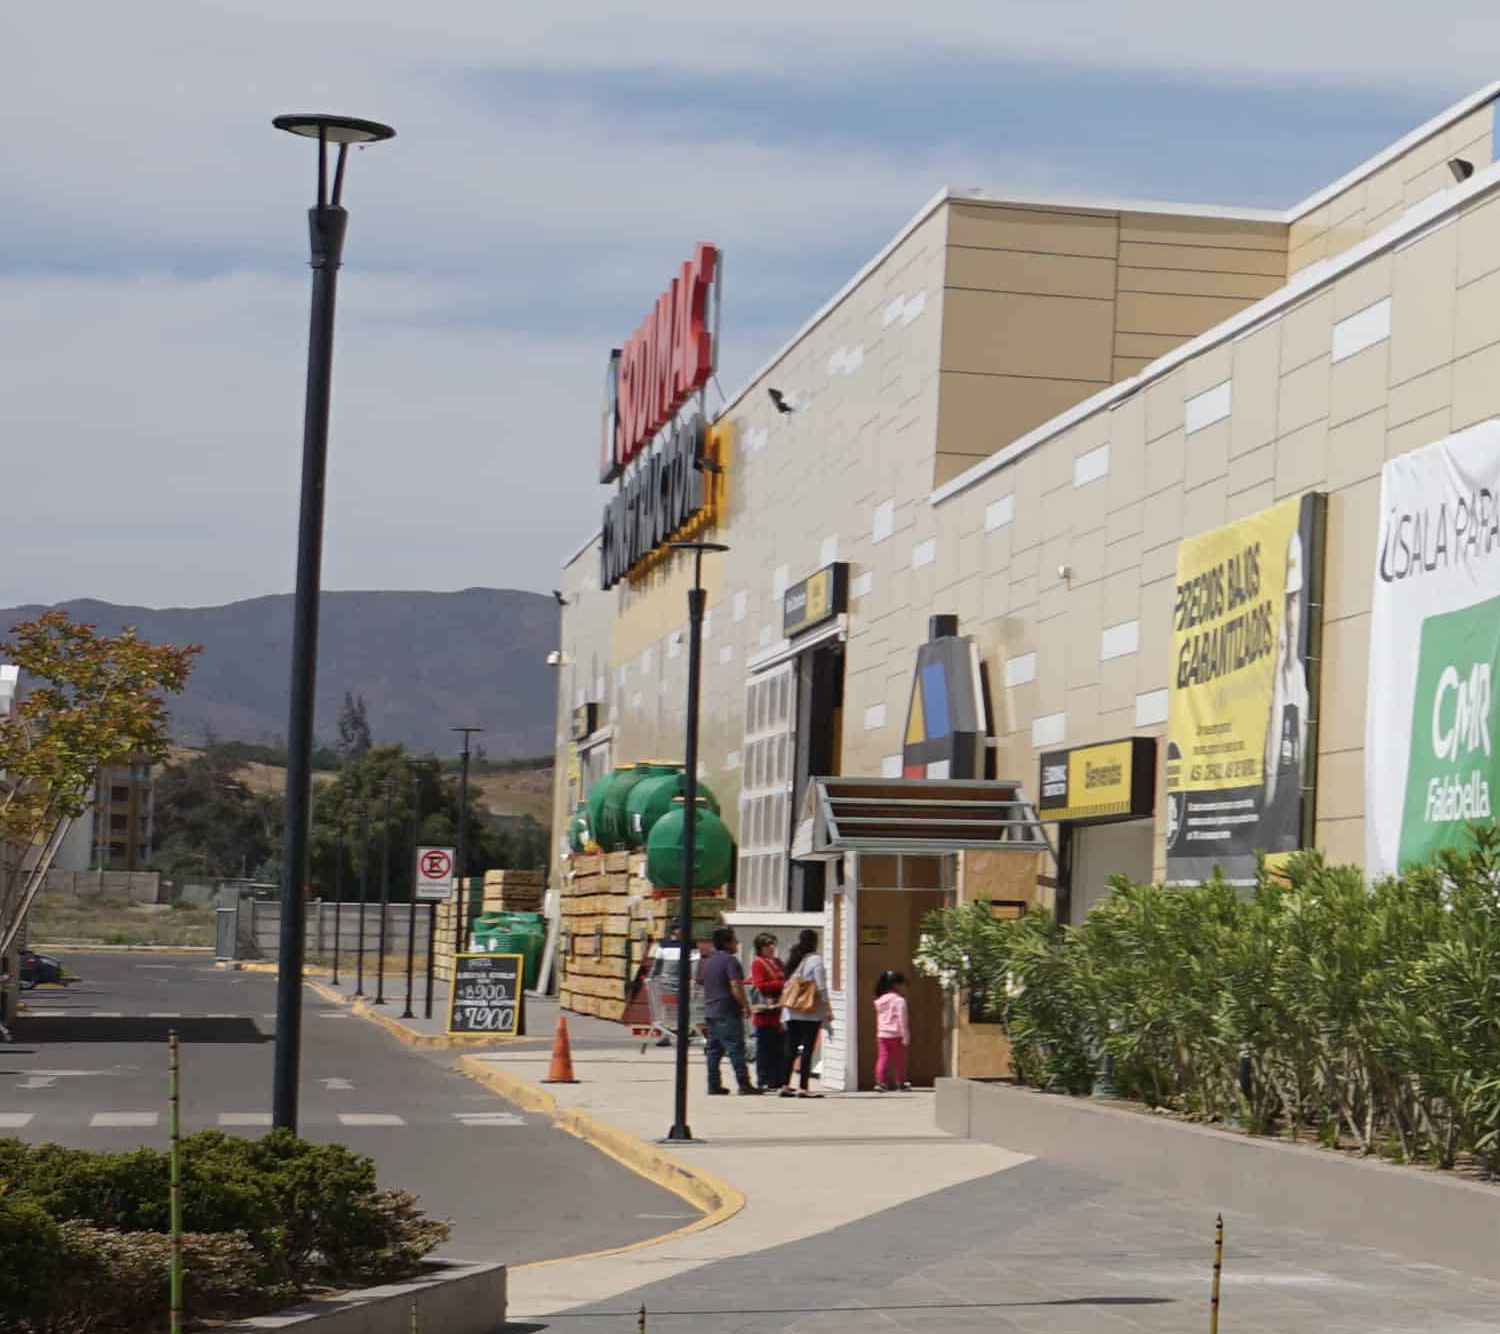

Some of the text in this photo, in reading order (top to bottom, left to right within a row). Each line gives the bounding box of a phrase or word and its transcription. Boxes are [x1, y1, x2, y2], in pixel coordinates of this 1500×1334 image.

[615, 241, 715, 467] SODIMAC
[1455, 488, 1500, 564] PARA
[1174, 541, 1262, 632] PRECIOS BAJOS
[1176, 600, 1273, 690] GARANTIZADOS
[1431, 662, 1492, 764] CMR
[1424, 769, 1492, 822] Falabella
